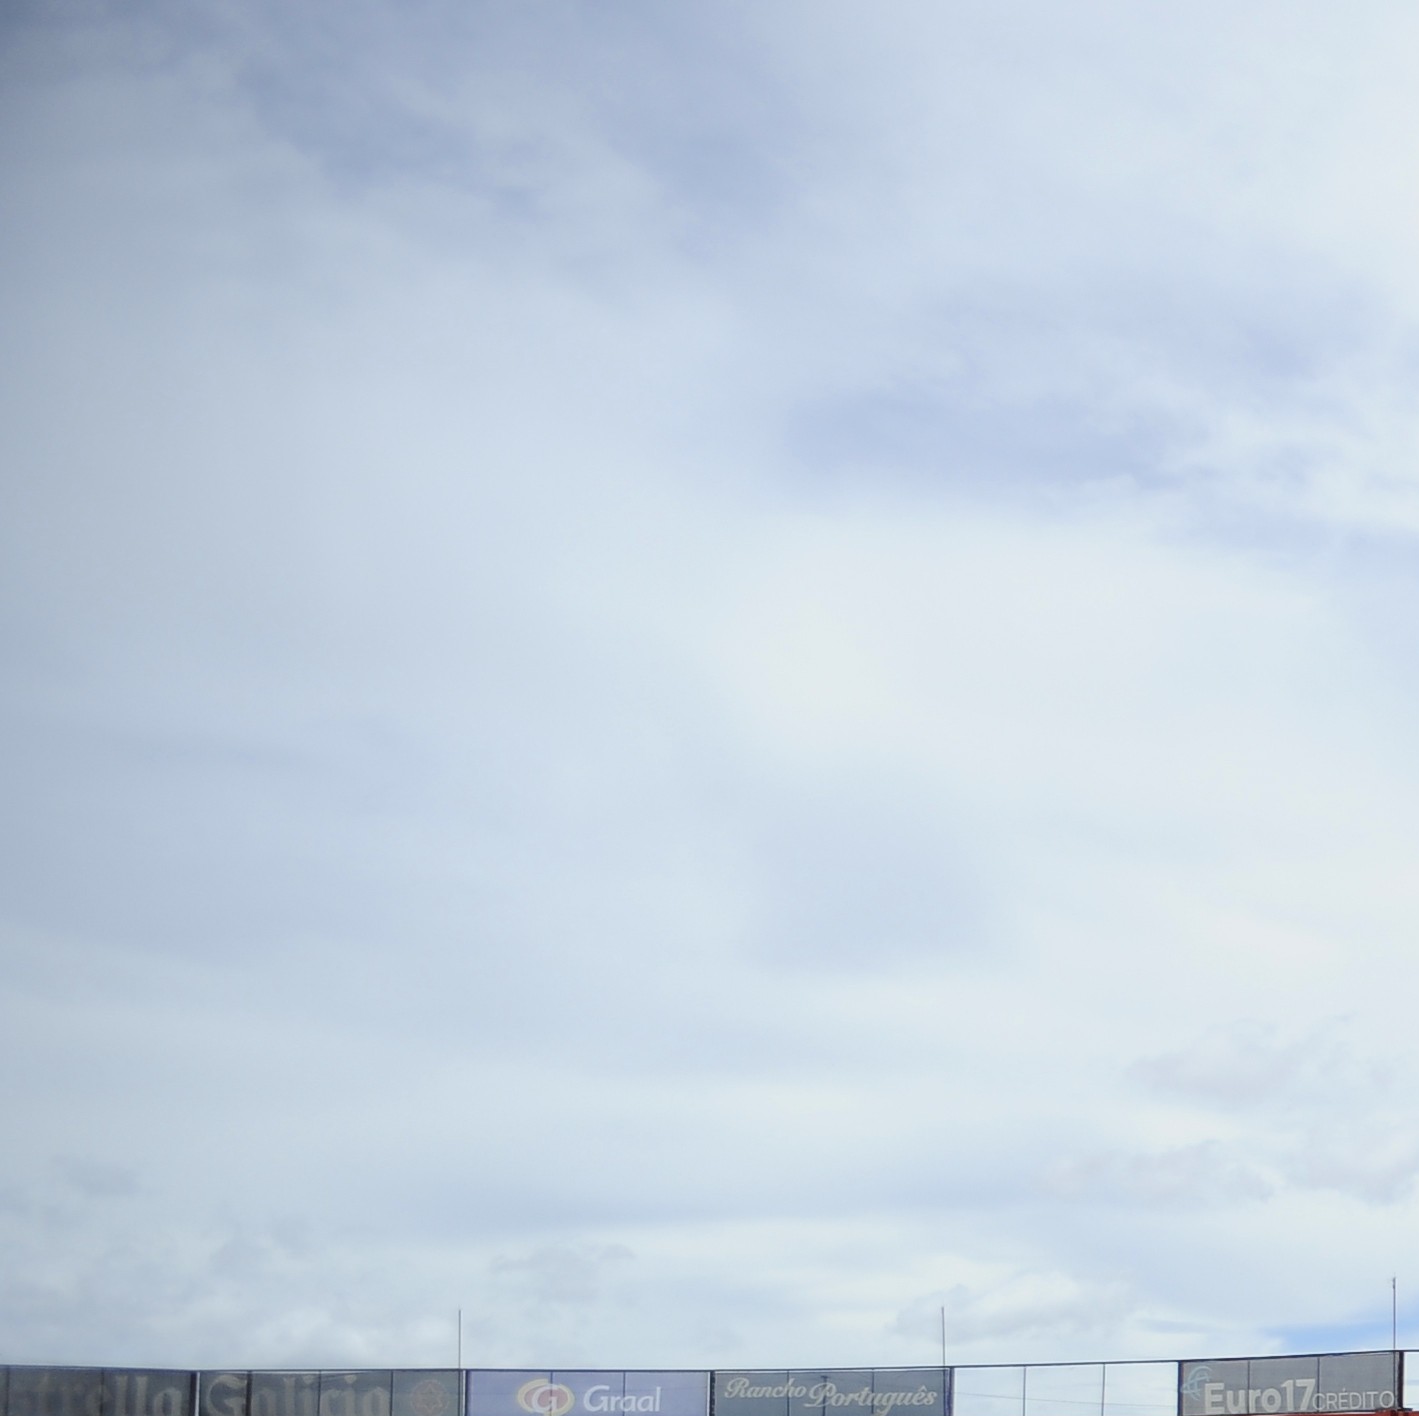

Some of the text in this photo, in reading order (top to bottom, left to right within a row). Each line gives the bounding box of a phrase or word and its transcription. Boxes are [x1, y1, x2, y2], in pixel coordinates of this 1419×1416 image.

[583, 1385, 661, 1412] Graal
[724, 1377, 807, 1398] Rancho
[1204, 1378, 1394, 1414] Euro17 CRÉDITO
